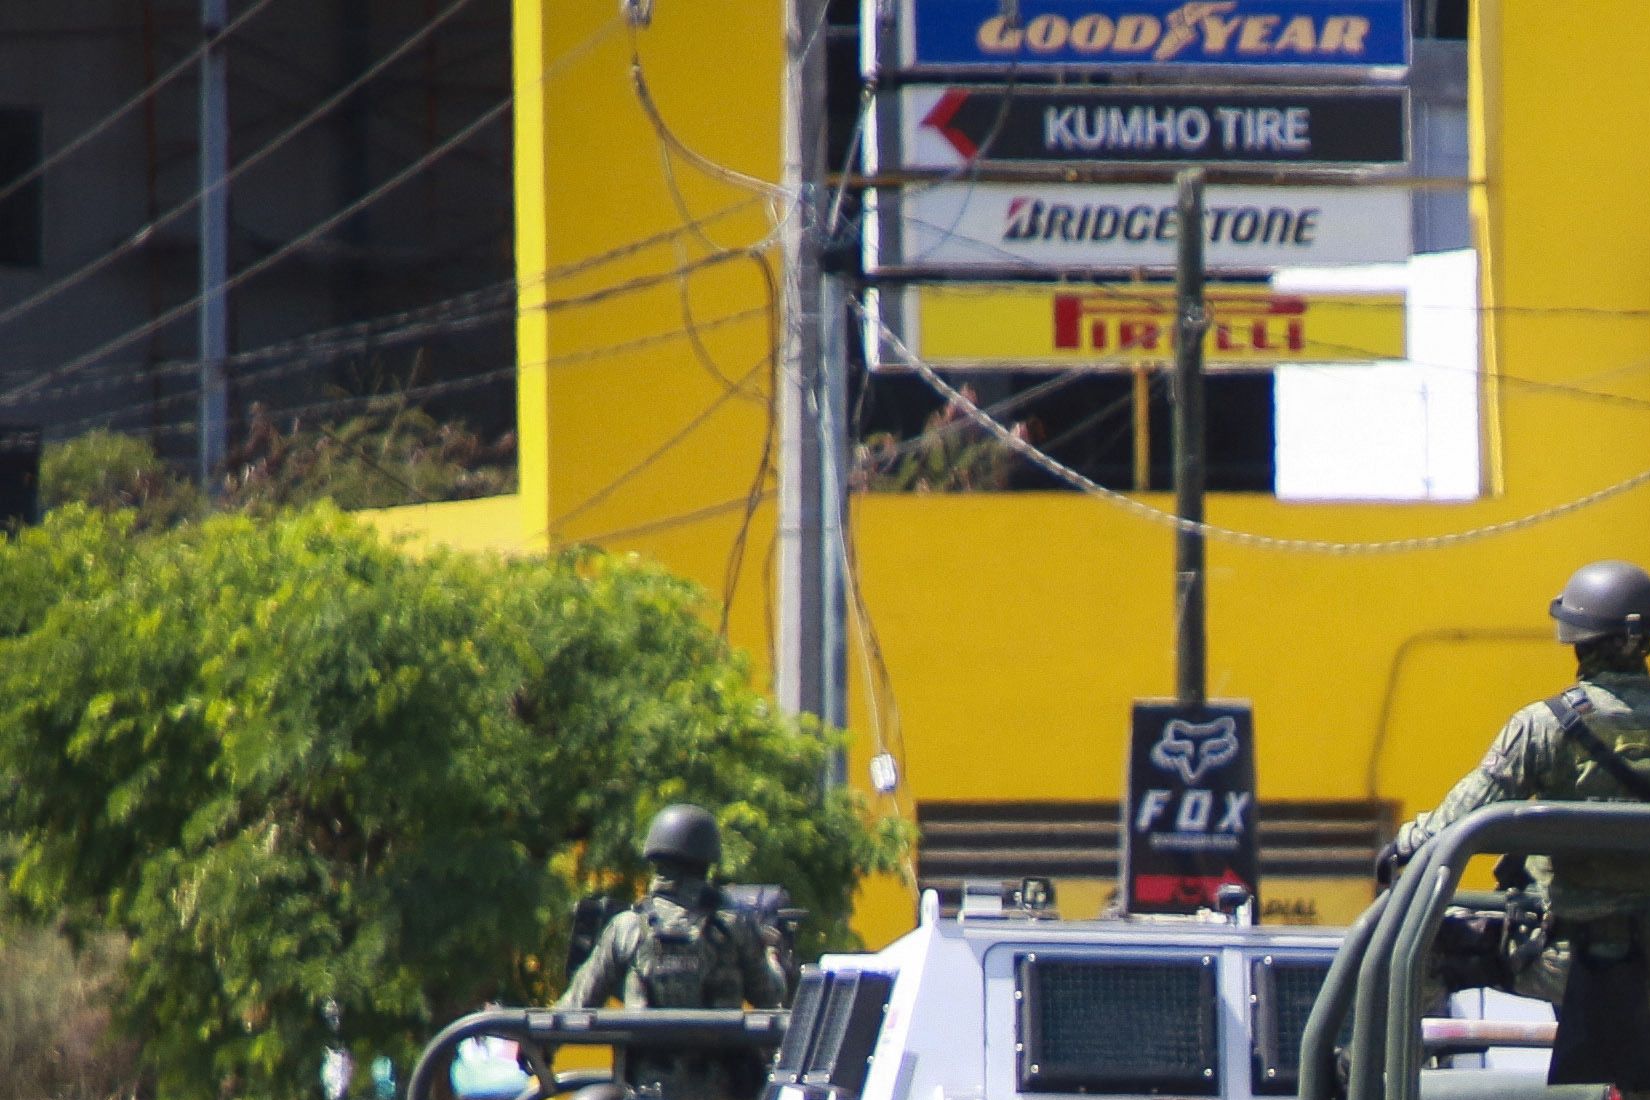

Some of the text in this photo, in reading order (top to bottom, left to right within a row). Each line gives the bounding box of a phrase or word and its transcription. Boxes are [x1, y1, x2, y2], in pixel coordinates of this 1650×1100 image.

[976, 14, 1370, 56] GOODYEAR
[1044, 107, 1311, 150] KUMHO TIRE
[1003, 196, 1320, 243] BRIDGETONE
[1054, 291, 1308, 350] PIRLLI
[1136, 789, 1249, 832] FOX
